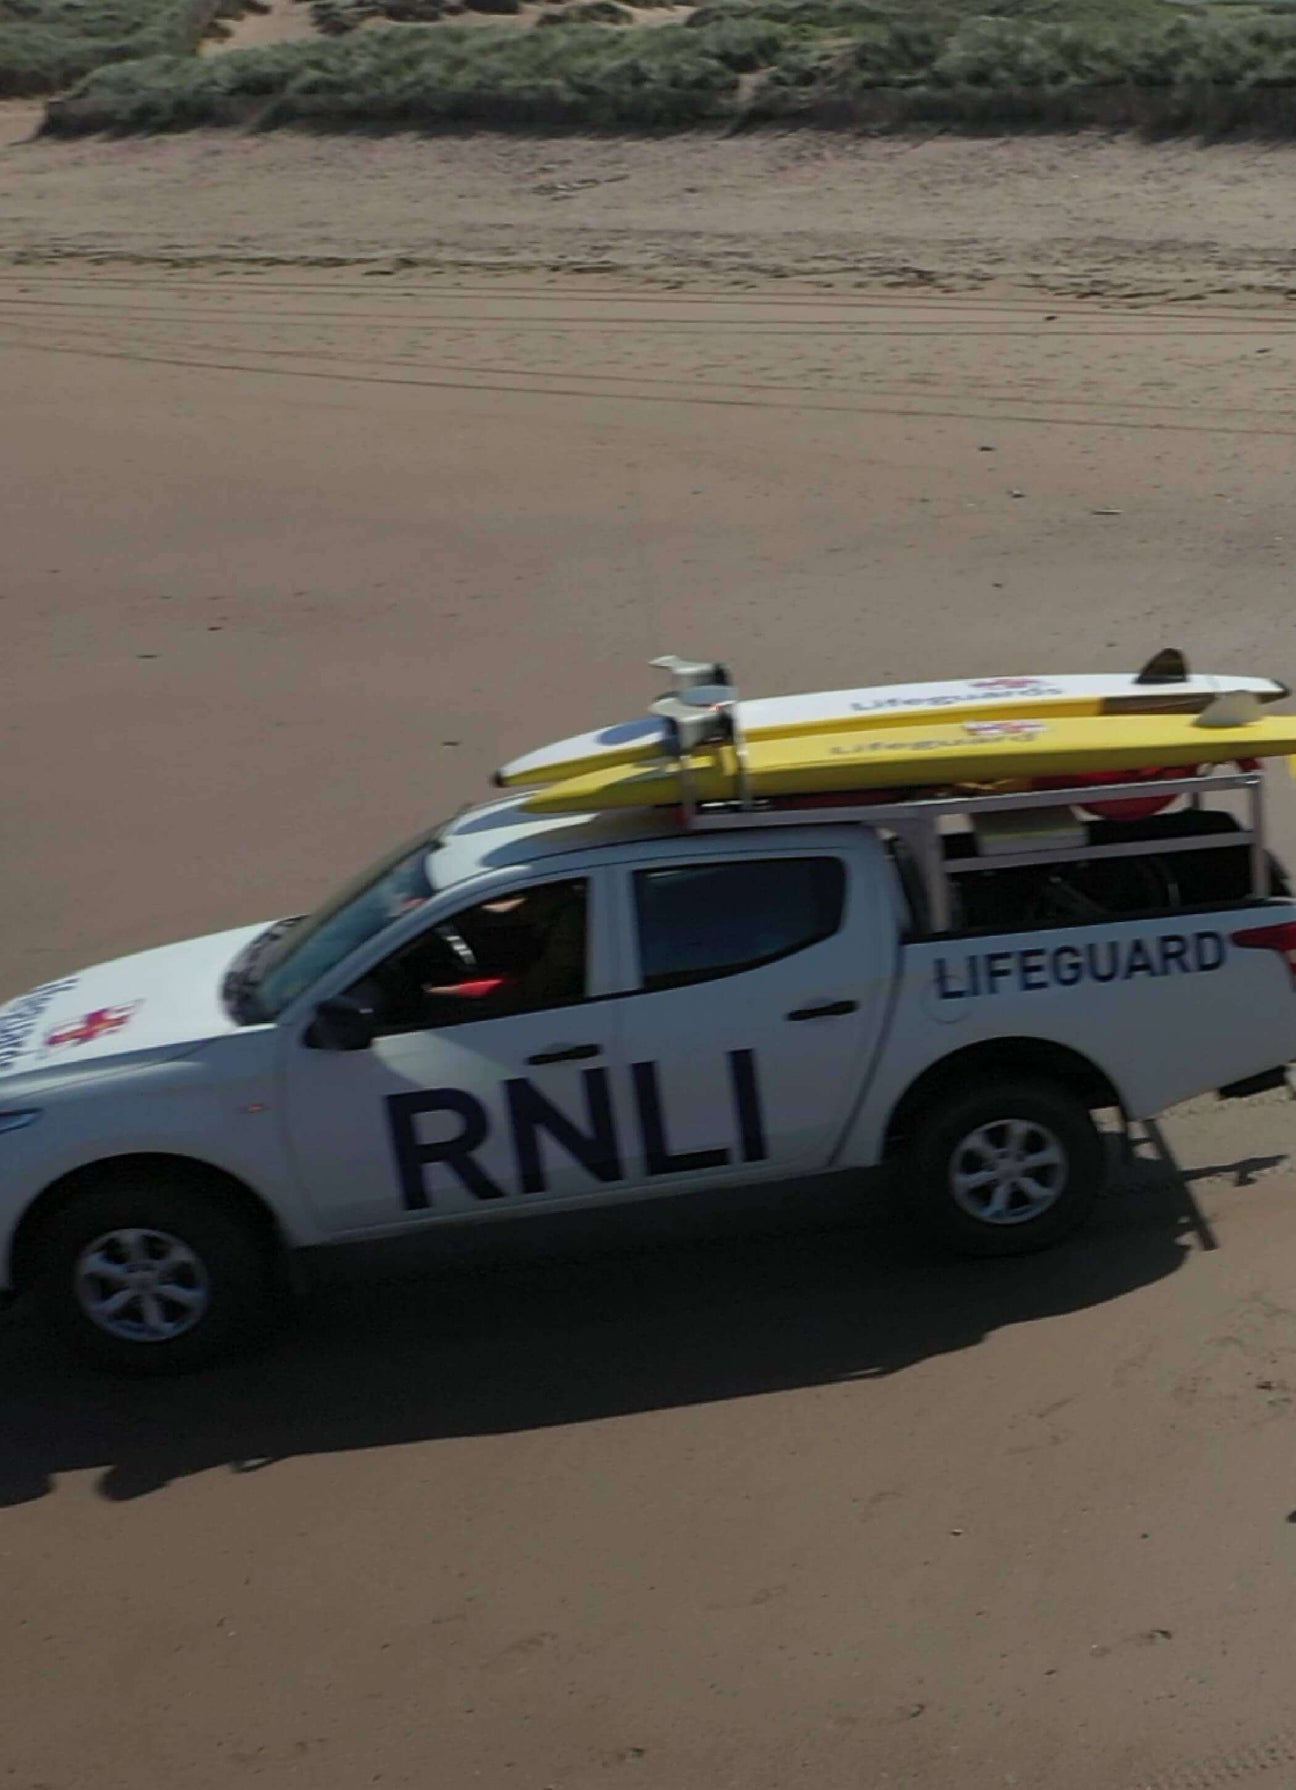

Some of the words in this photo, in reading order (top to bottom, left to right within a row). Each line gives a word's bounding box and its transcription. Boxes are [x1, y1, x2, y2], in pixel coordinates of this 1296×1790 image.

[852, 687, 1063, 711] Lifeguards
[934, 931, 1226, 999] LIFEGUARD
[384, 1048, 767, 1210] RNLI
